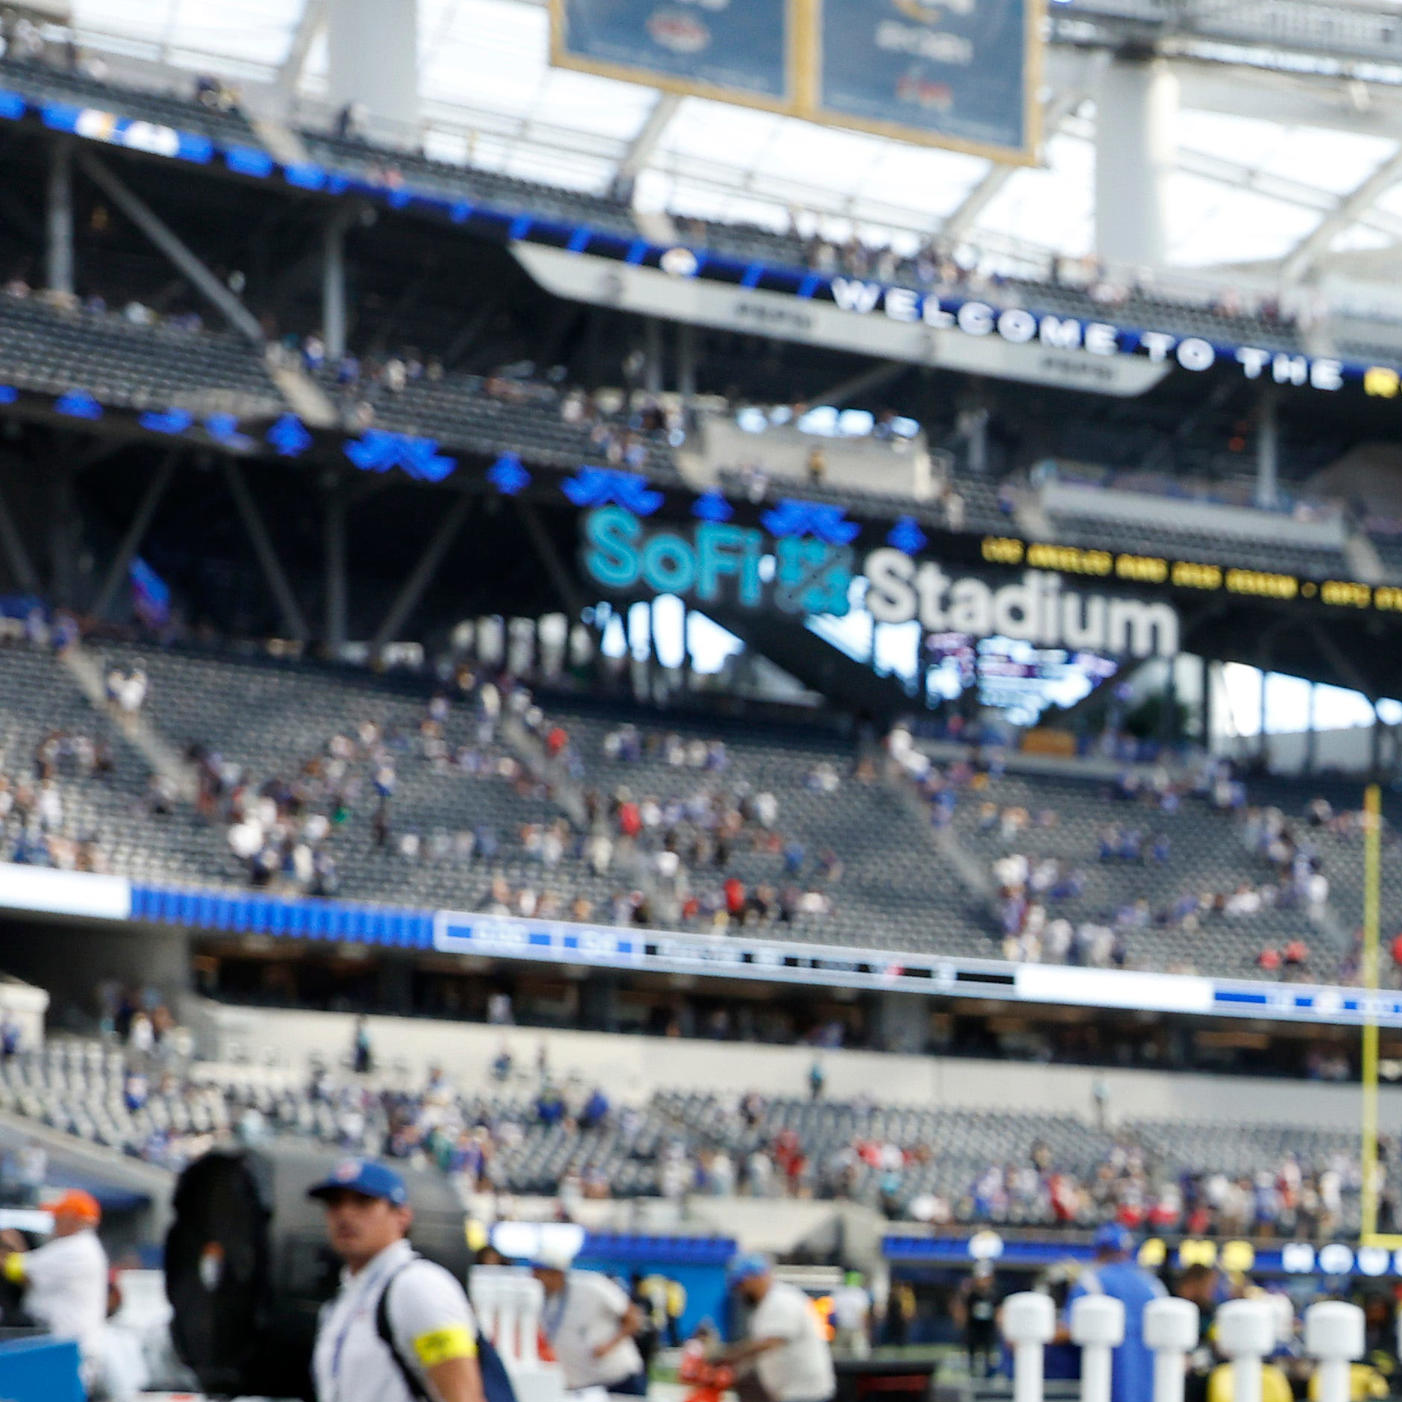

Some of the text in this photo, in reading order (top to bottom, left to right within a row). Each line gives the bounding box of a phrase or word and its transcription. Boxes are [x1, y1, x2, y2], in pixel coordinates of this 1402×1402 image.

[831, 276, 1119, 356] WELCOME
[1140, 330, 1215, 372] TO
[1235, 345, 1344, 392] THE
[585, 505, 1180, 659] SoFi Stadium
